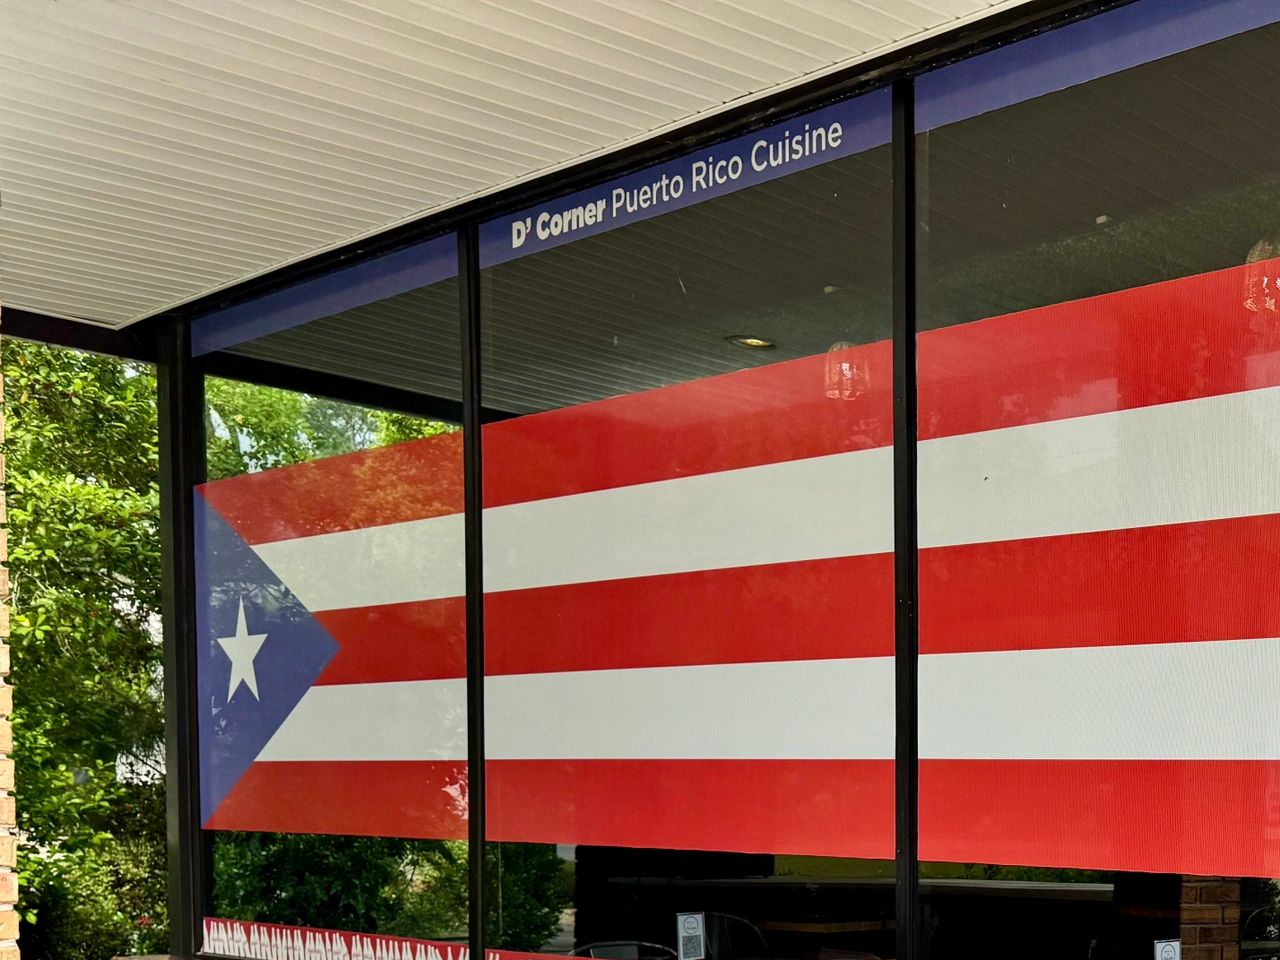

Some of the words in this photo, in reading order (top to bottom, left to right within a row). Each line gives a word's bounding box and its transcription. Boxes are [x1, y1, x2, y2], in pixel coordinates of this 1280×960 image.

[512, 220, 532, 248] D'
[536, 199, 606, 241] Corner
[612, 174, 684, 218] Puerto
[690, 155, 743, 193] Rico
[751, 122, 843, 172] Cuisine
